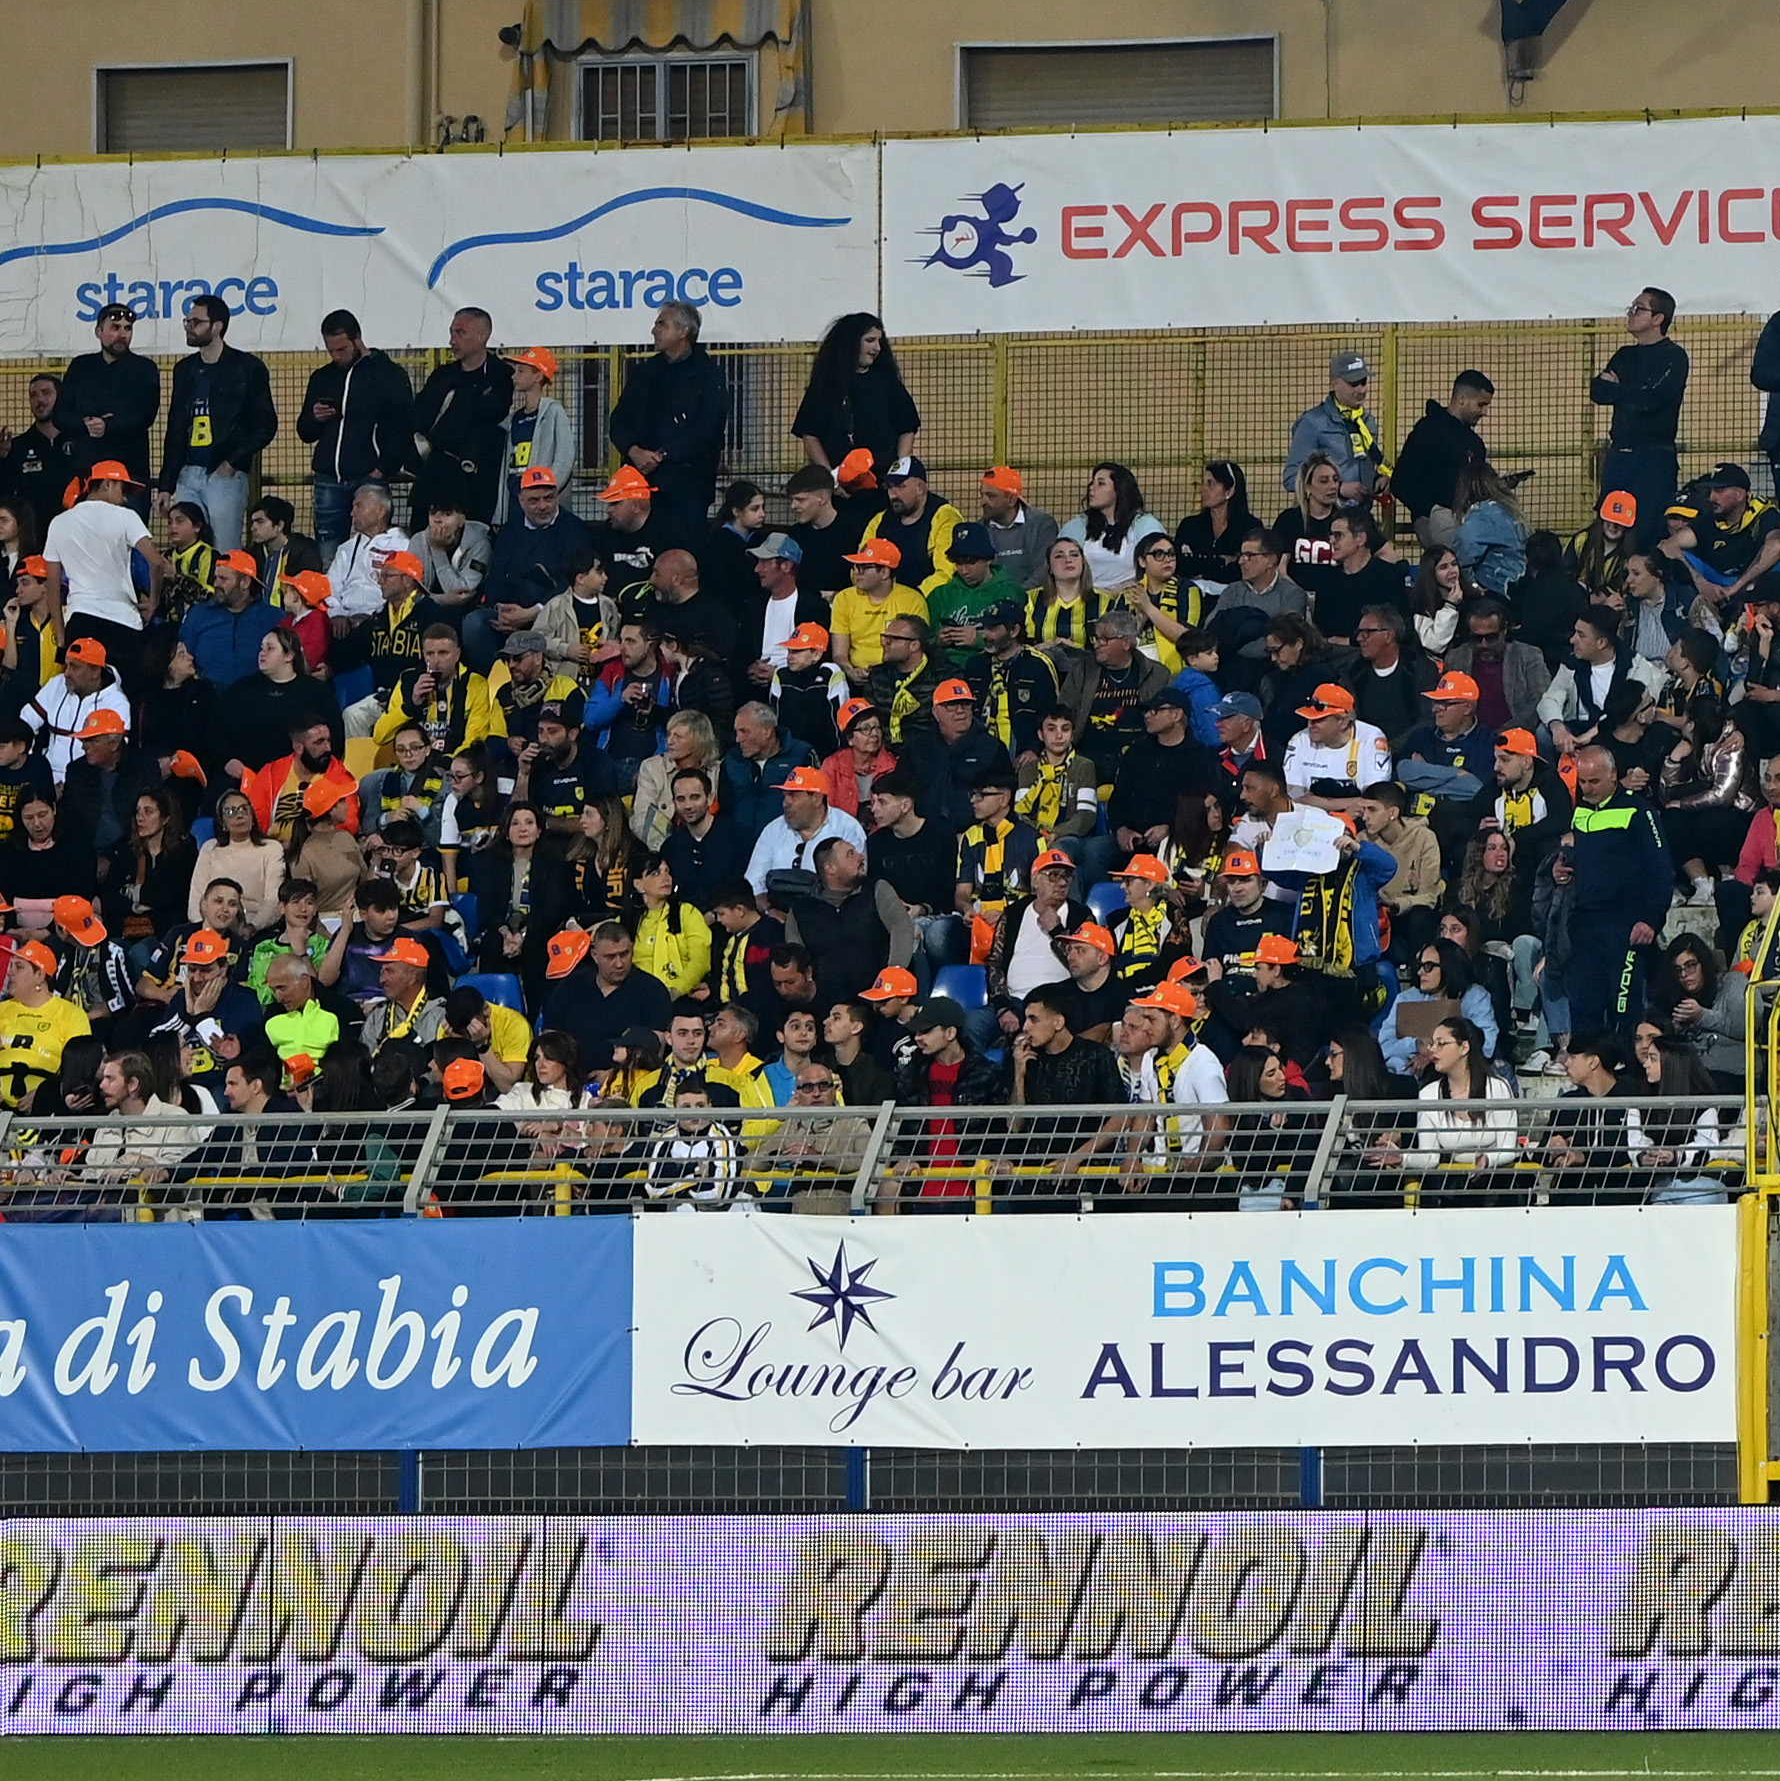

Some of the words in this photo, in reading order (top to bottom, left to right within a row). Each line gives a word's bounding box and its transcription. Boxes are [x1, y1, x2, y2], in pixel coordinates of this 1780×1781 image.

[1061, 196, 1446, 260] EXPRESS
[75, 271, 280, 323] starace
[535, 261, 743, 312] starace
[1645, 809, 1662, 849] GIVOVA
[1616, 949, 1637, 1014] GIVOVA
[1151, 1254, 1650, 1318] BANCHINA
[53, 1280, 164, 1398] di
[188, 1275, 541, 1392] Stabia
[1079, 1334, 1717, 1400] ALESSANDRO
[669, 1316, 916, 1434] Lounge
[932, 1341, 1035, 1402] bar
[767, 1527, 1440, 1663] RENNOIL
[4, 1671, 174, 1715] IGH
[236, 1668, 583, 1713] POWER
[758, 1669, 1008, 1716] HIGH
[1068, 1663, 1426, 1713] POWER
